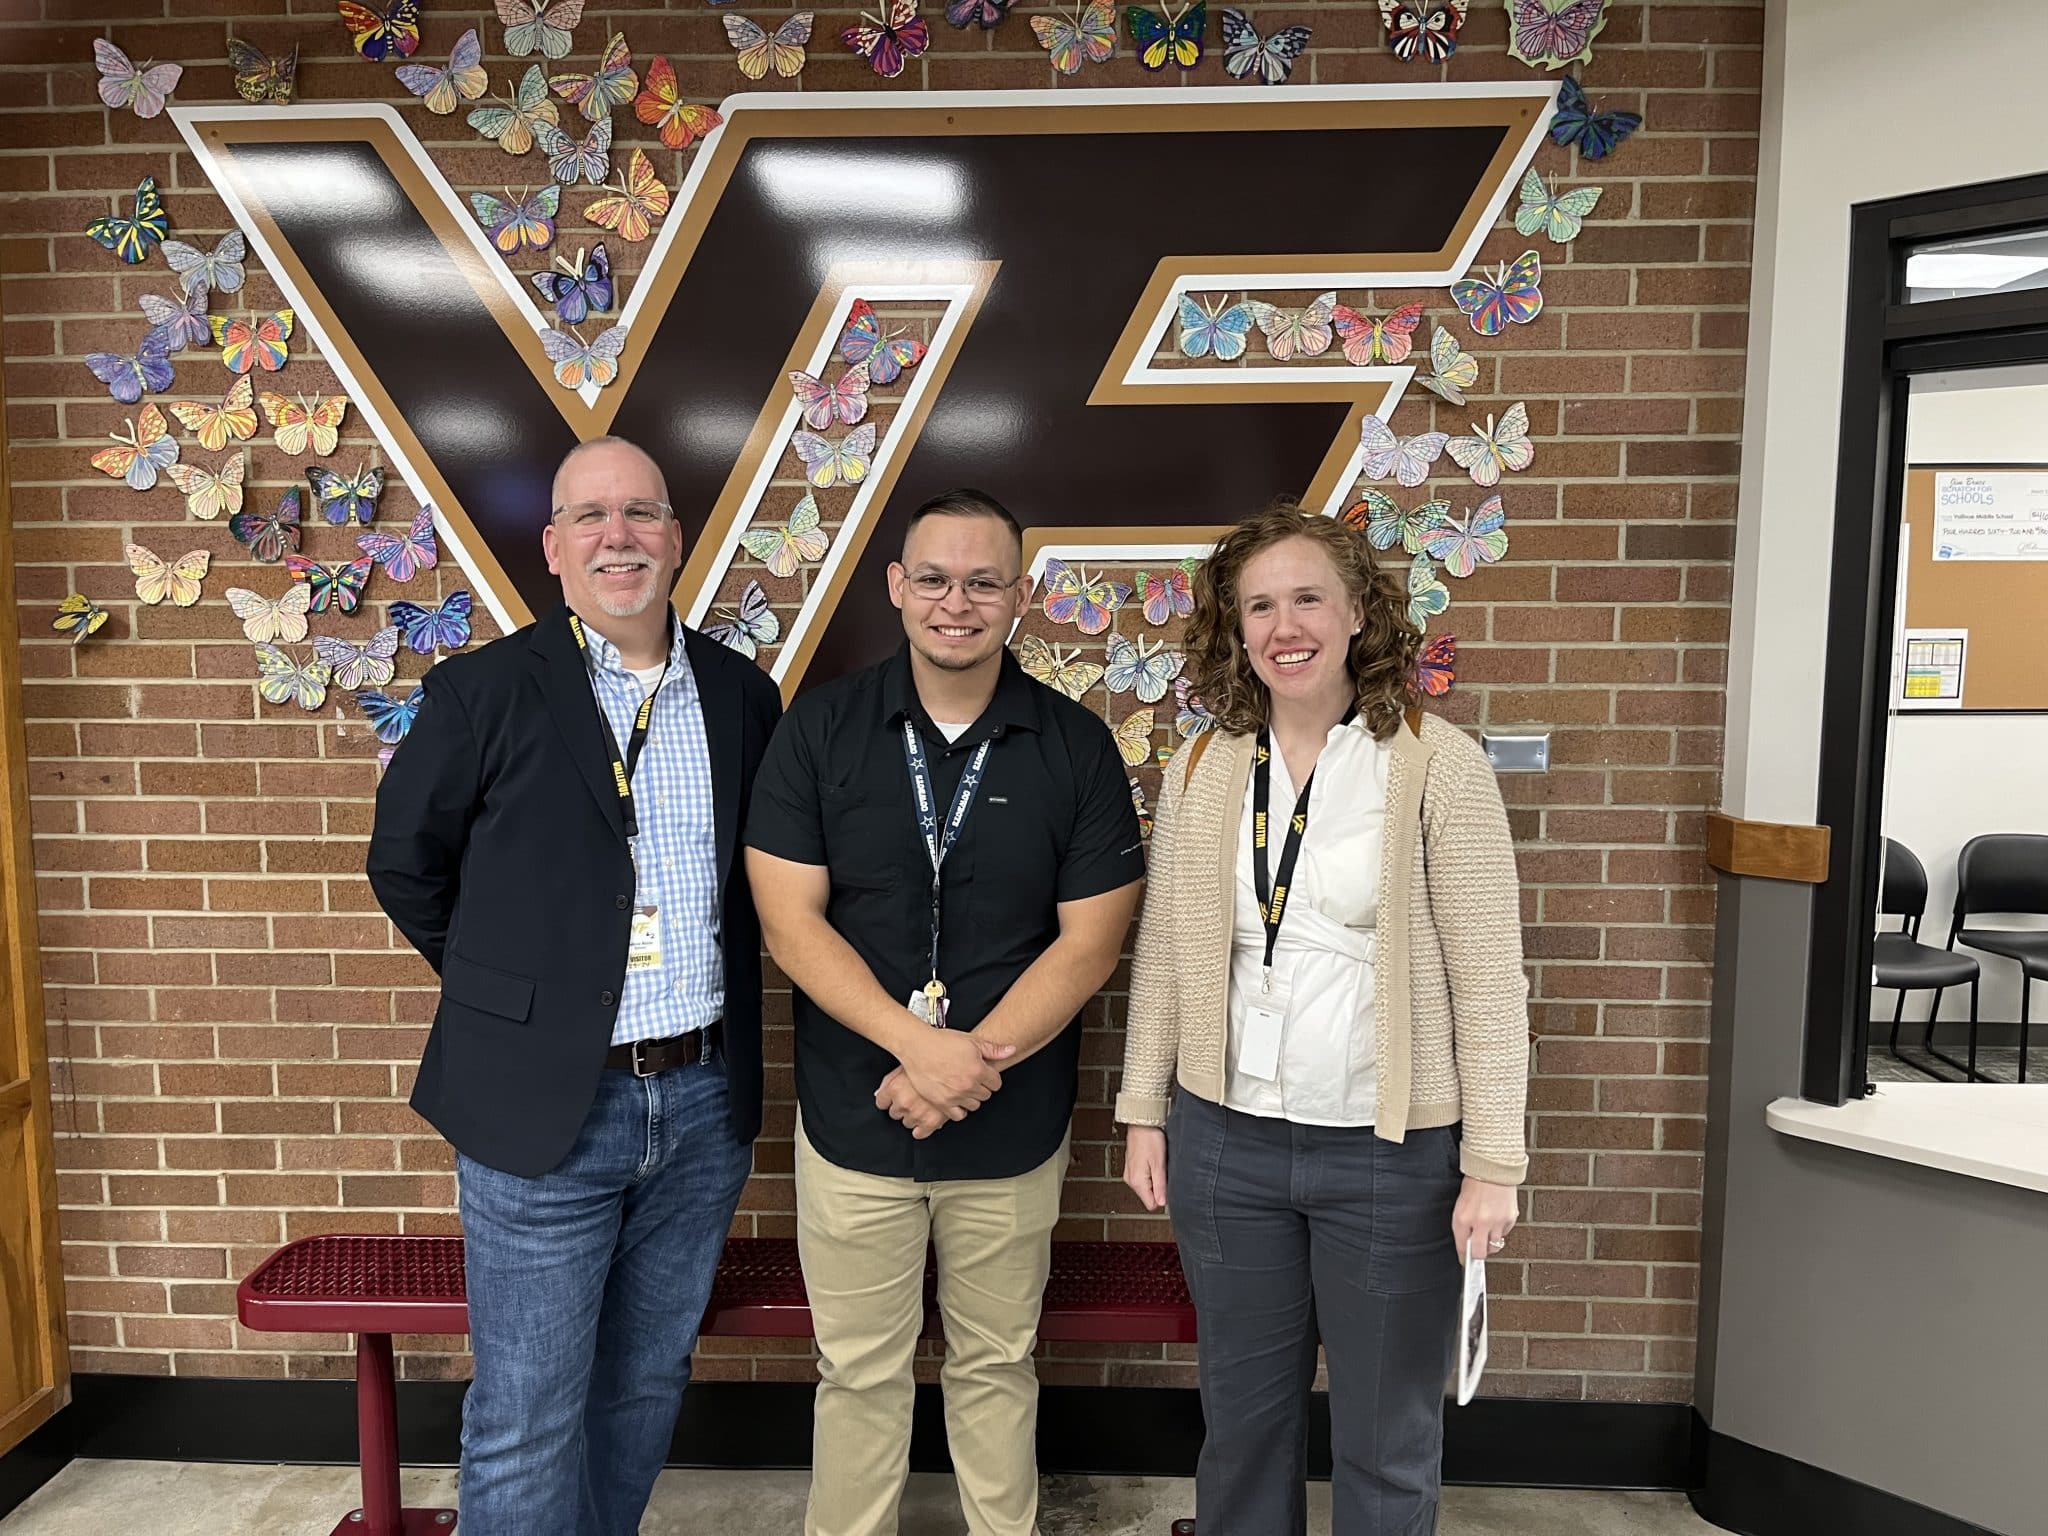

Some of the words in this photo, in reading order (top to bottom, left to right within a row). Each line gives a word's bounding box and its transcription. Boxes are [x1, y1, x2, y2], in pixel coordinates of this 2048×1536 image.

[1941, 492, 1994, 505] SCHOOLS
[568, 615, 586, 649] VALLIVUE
[1255, 745, 1270, 766] VF
[613, 761, 629, 797] VALLIVUE
[914, 775, 929, 812] COWBOYS
[952, 789, 971, 828] COWBOYS
[1292, 814, 1306, 836] VF
[1255, 811, 1267, 849] VALLIVUE
[1269, 886, 1287, 924] VALLIVUE
[630, 954, 652, 963] VISITOR
